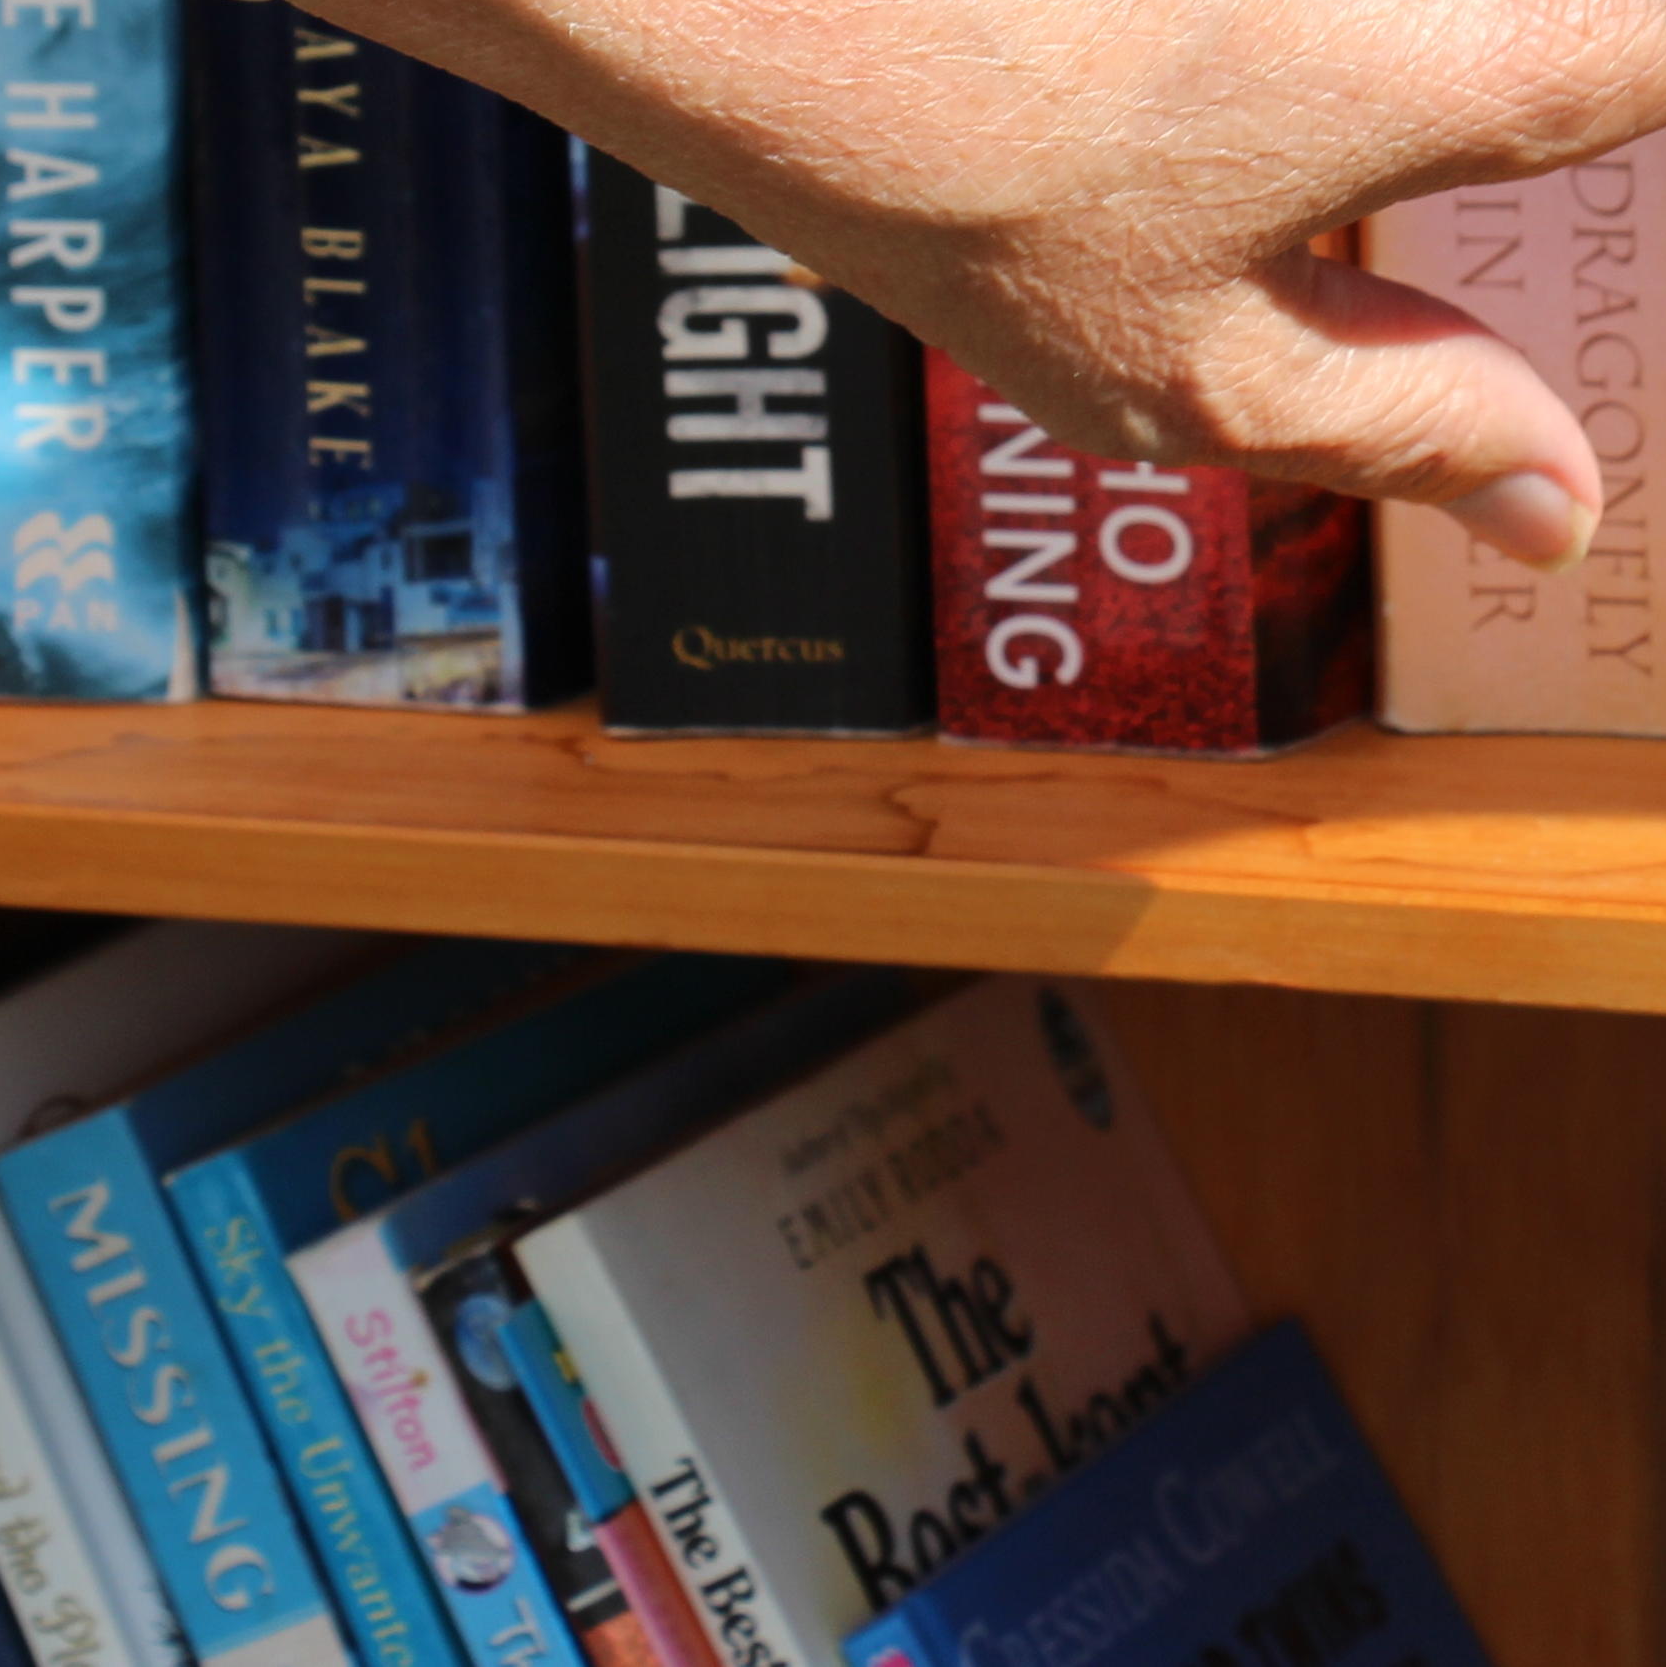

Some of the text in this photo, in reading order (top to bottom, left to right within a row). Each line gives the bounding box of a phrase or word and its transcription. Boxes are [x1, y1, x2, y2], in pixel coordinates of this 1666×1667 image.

[3, 80, 109, 454] HARPER
[294, 27, 372, 471] AYA BLAKE
[1455, 197, 1525, 292] IN
[671, 624, 845, 669] Quercus
[976, 403, 1083, 690] NING
[49, 1179, 277, 1612] MISSING
[204, 1216, 275, 1322] Sky
[253, 1339, 312, 1428] the
[343, 1307, 438, 1473] Stilton
[863, 1243, 1033, 1407] The
[652, 1457, 790, 1667] The Bes
